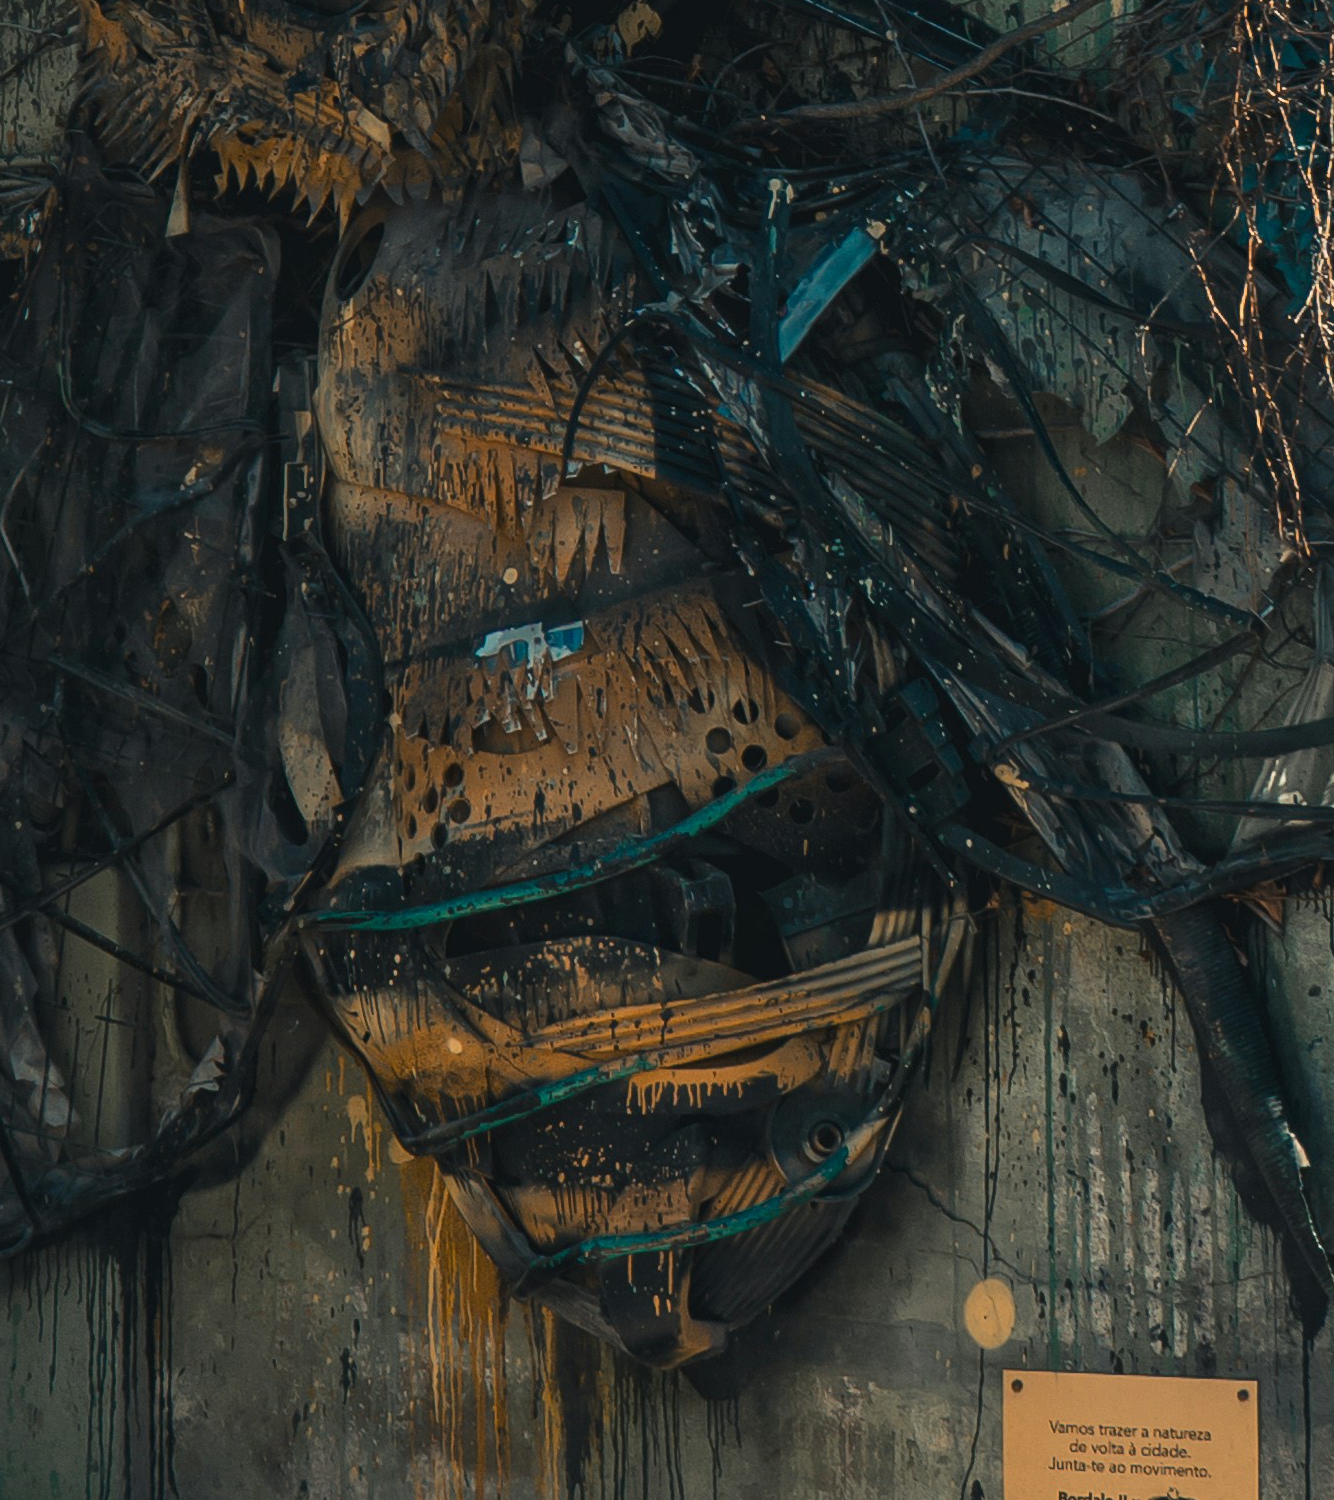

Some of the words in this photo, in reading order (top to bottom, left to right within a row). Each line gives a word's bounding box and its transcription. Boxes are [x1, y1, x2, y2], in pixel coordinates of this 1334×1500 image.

[1049, 1419, 1095, 1435] Vamos
[1098, 1424, 1138, 1439] trazer
[1141, 1427, 1149, 1439] a
[1153, 1427, 1212, 1442] natureza
[1069, 1438, 1087, 1454] de
[1091, 1441, 1125, 1456] volta
[1128, 1442, 1137, 1456] à
[1140, 1443, 1192, 1459] cidade.
[1048, 1456, 1105, 1473] Junta-te
[1108, 1463, 1127, 1474] ao
[1130, 1462, 1212, 1479] movimento.
